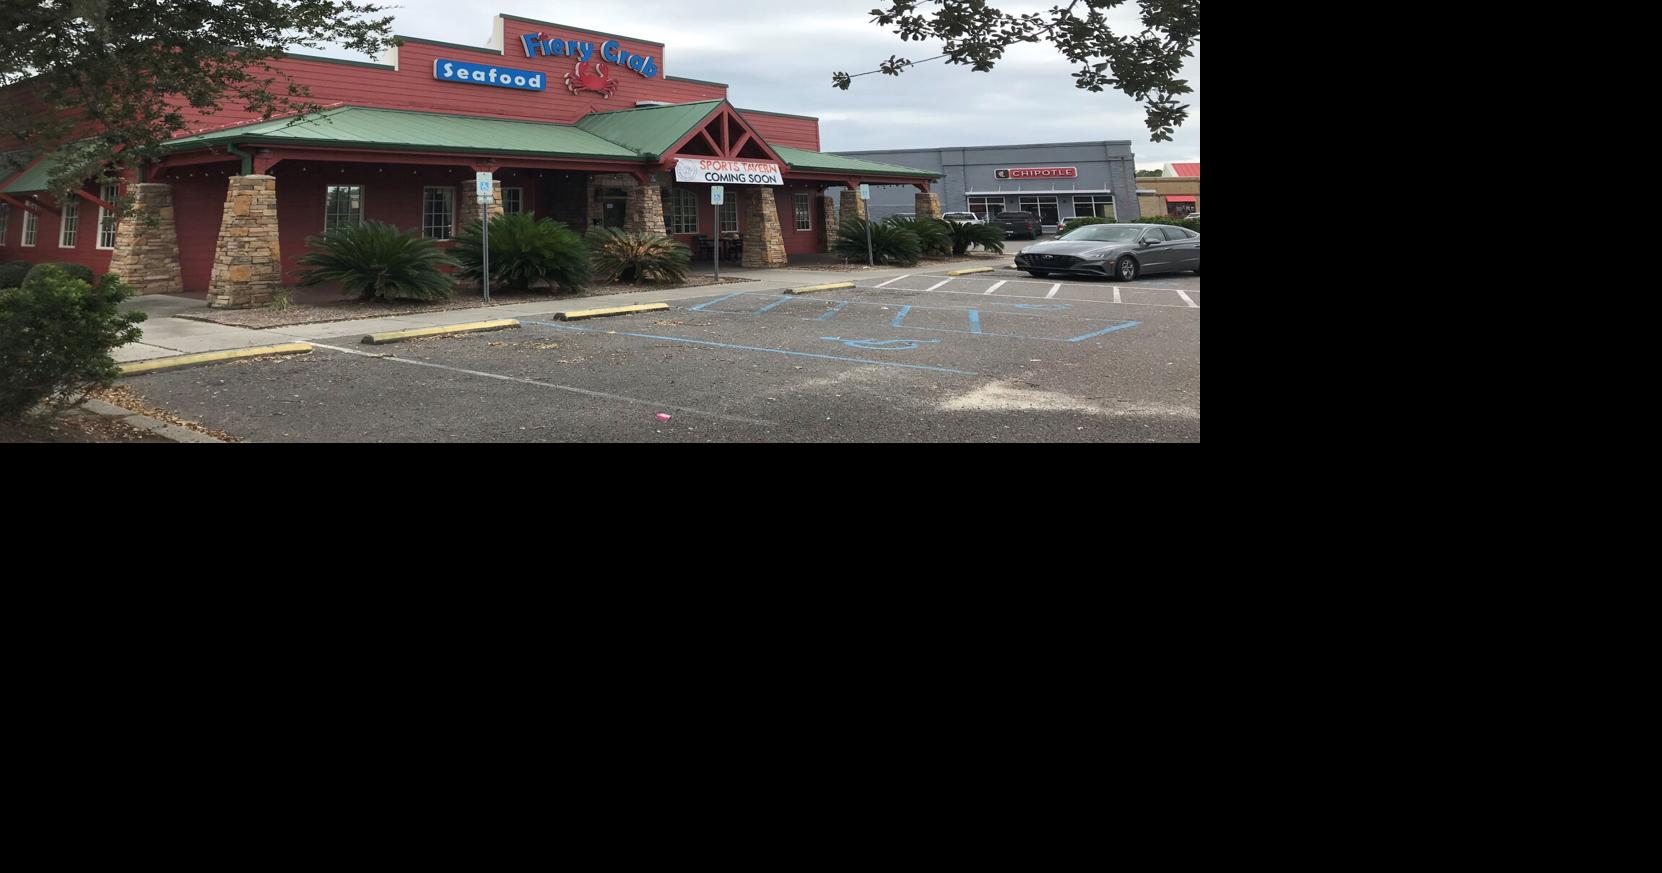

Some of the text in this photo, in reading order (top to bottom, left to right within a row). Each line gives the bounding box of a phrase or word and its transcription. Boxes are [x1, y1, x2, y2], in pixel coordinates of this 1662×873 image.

[520, 33, 658, 78] Fiery Crab
[443, 63, 541, 88] Seafood
[700, 160, 739, 171] SPORTS
[743, 163, 777, 173] TAVERN
[1012, 169, 1073, 177] CHIPOTLE
[704, 172, 777, 183] COMING SOON
